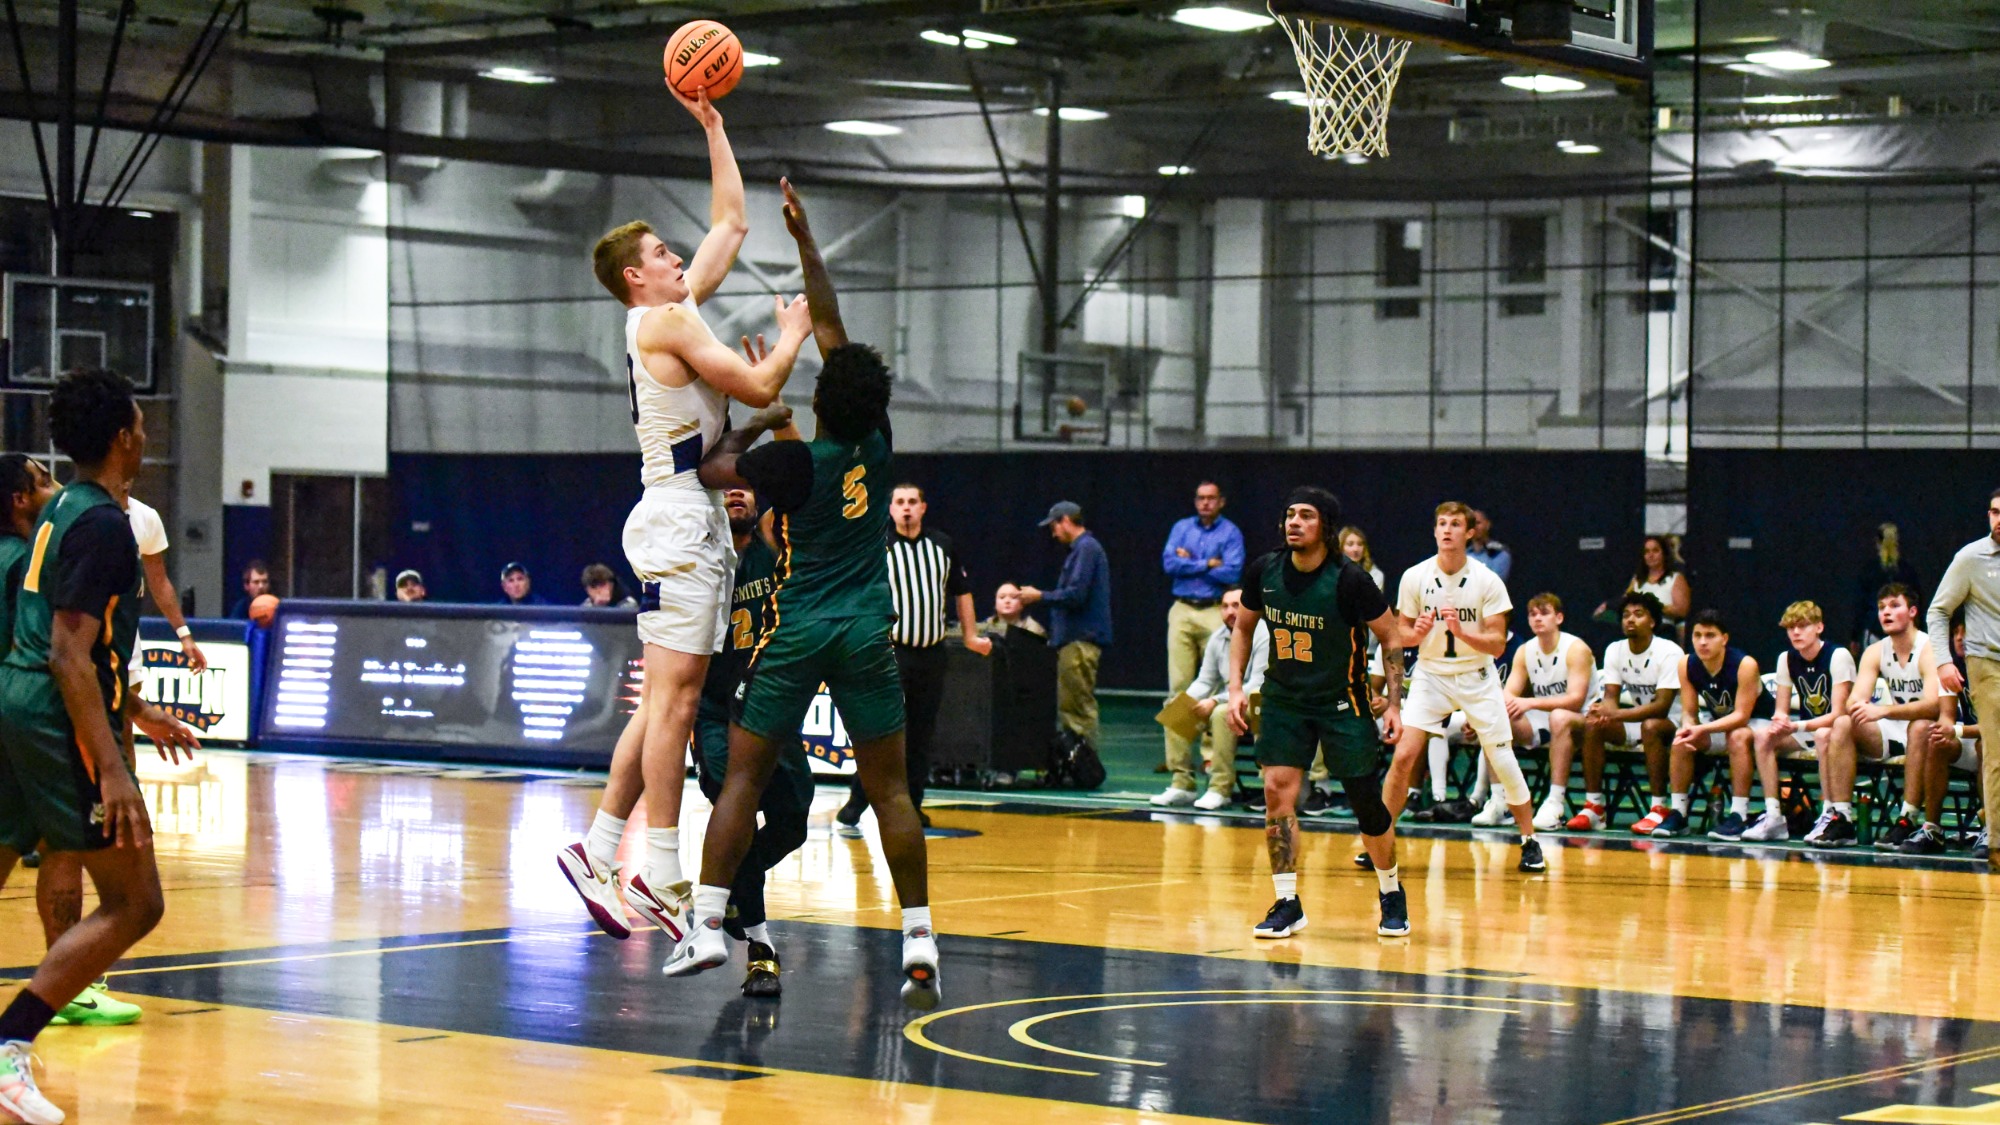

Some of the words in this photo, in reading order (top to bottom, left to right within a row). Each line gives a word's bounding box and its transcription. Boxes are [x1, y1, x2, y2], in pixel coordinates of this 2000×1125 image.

[676, 28, 720, 67] Wilson
[703, 51, 729, 80] EVO
[841, 464, 868, 519] 5
[23, 520, 54, 593] 1
[733, 577, 771, 604] SMITH'S
[730, 607, 754, 650] 2
[1264, 604, 1283, 624] PAUL
[1285, 611, 1325, 630] SMITH'S
[1424, 605, 1477, 622] AON
[147, 650, 186, 666] UNY
[1273, 628, 1313, 663] 22
[1444, 629, 1457, 658] 1
[138, 666, 226, 715] NTON
